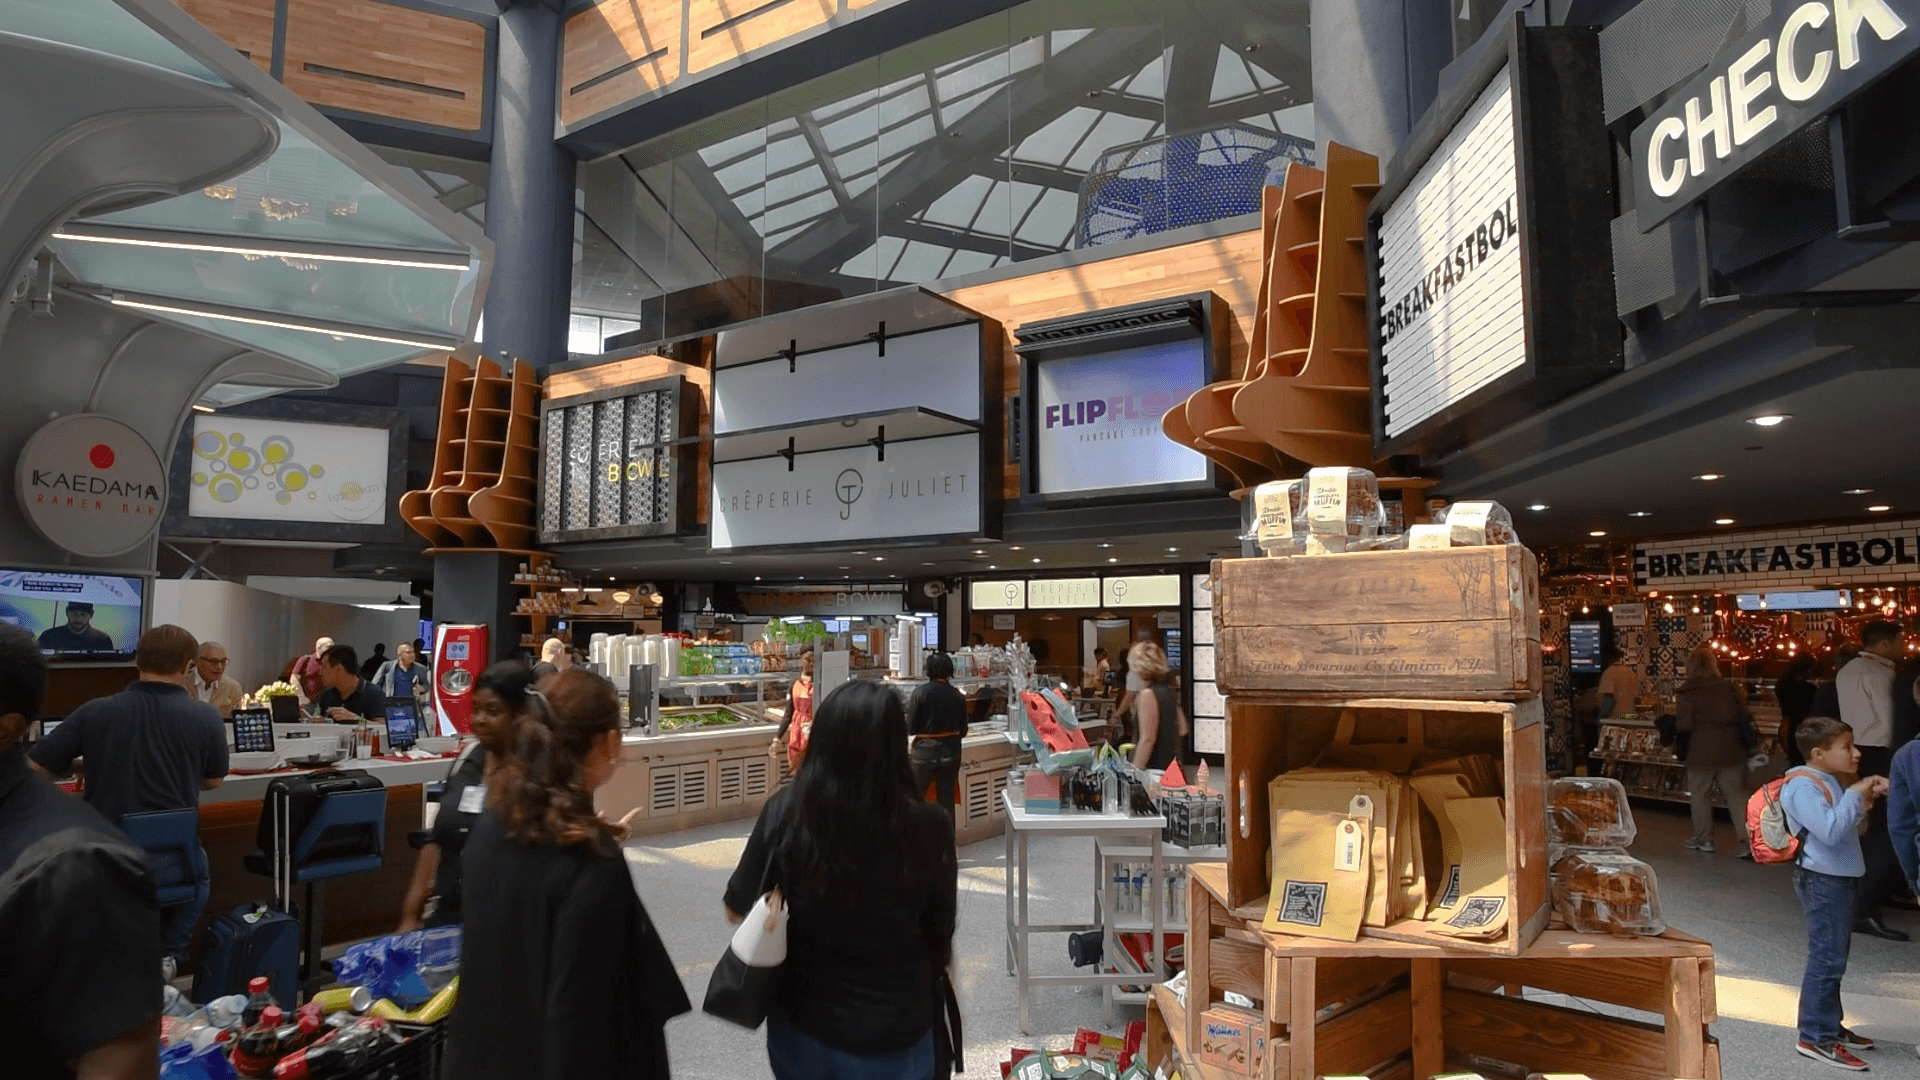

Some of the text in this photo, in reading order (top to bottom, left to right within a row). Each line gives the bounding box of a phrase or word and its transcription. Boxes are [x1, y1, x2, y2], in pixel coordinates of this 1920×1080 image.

[1648, 0, 1907, 197] CHECK
[1387, 197, 1517, 341] BREAKFASTBOL
[32, 469, 160, 501] KAEDAMA
[36, 493, 155, 516] RAMEN BAR
[719, 489, 813, 513] CRÊPERIE
[889, 474, 967, 499] JULIET
[1649, 536, 1920, 577] BREAKFASTBOL
